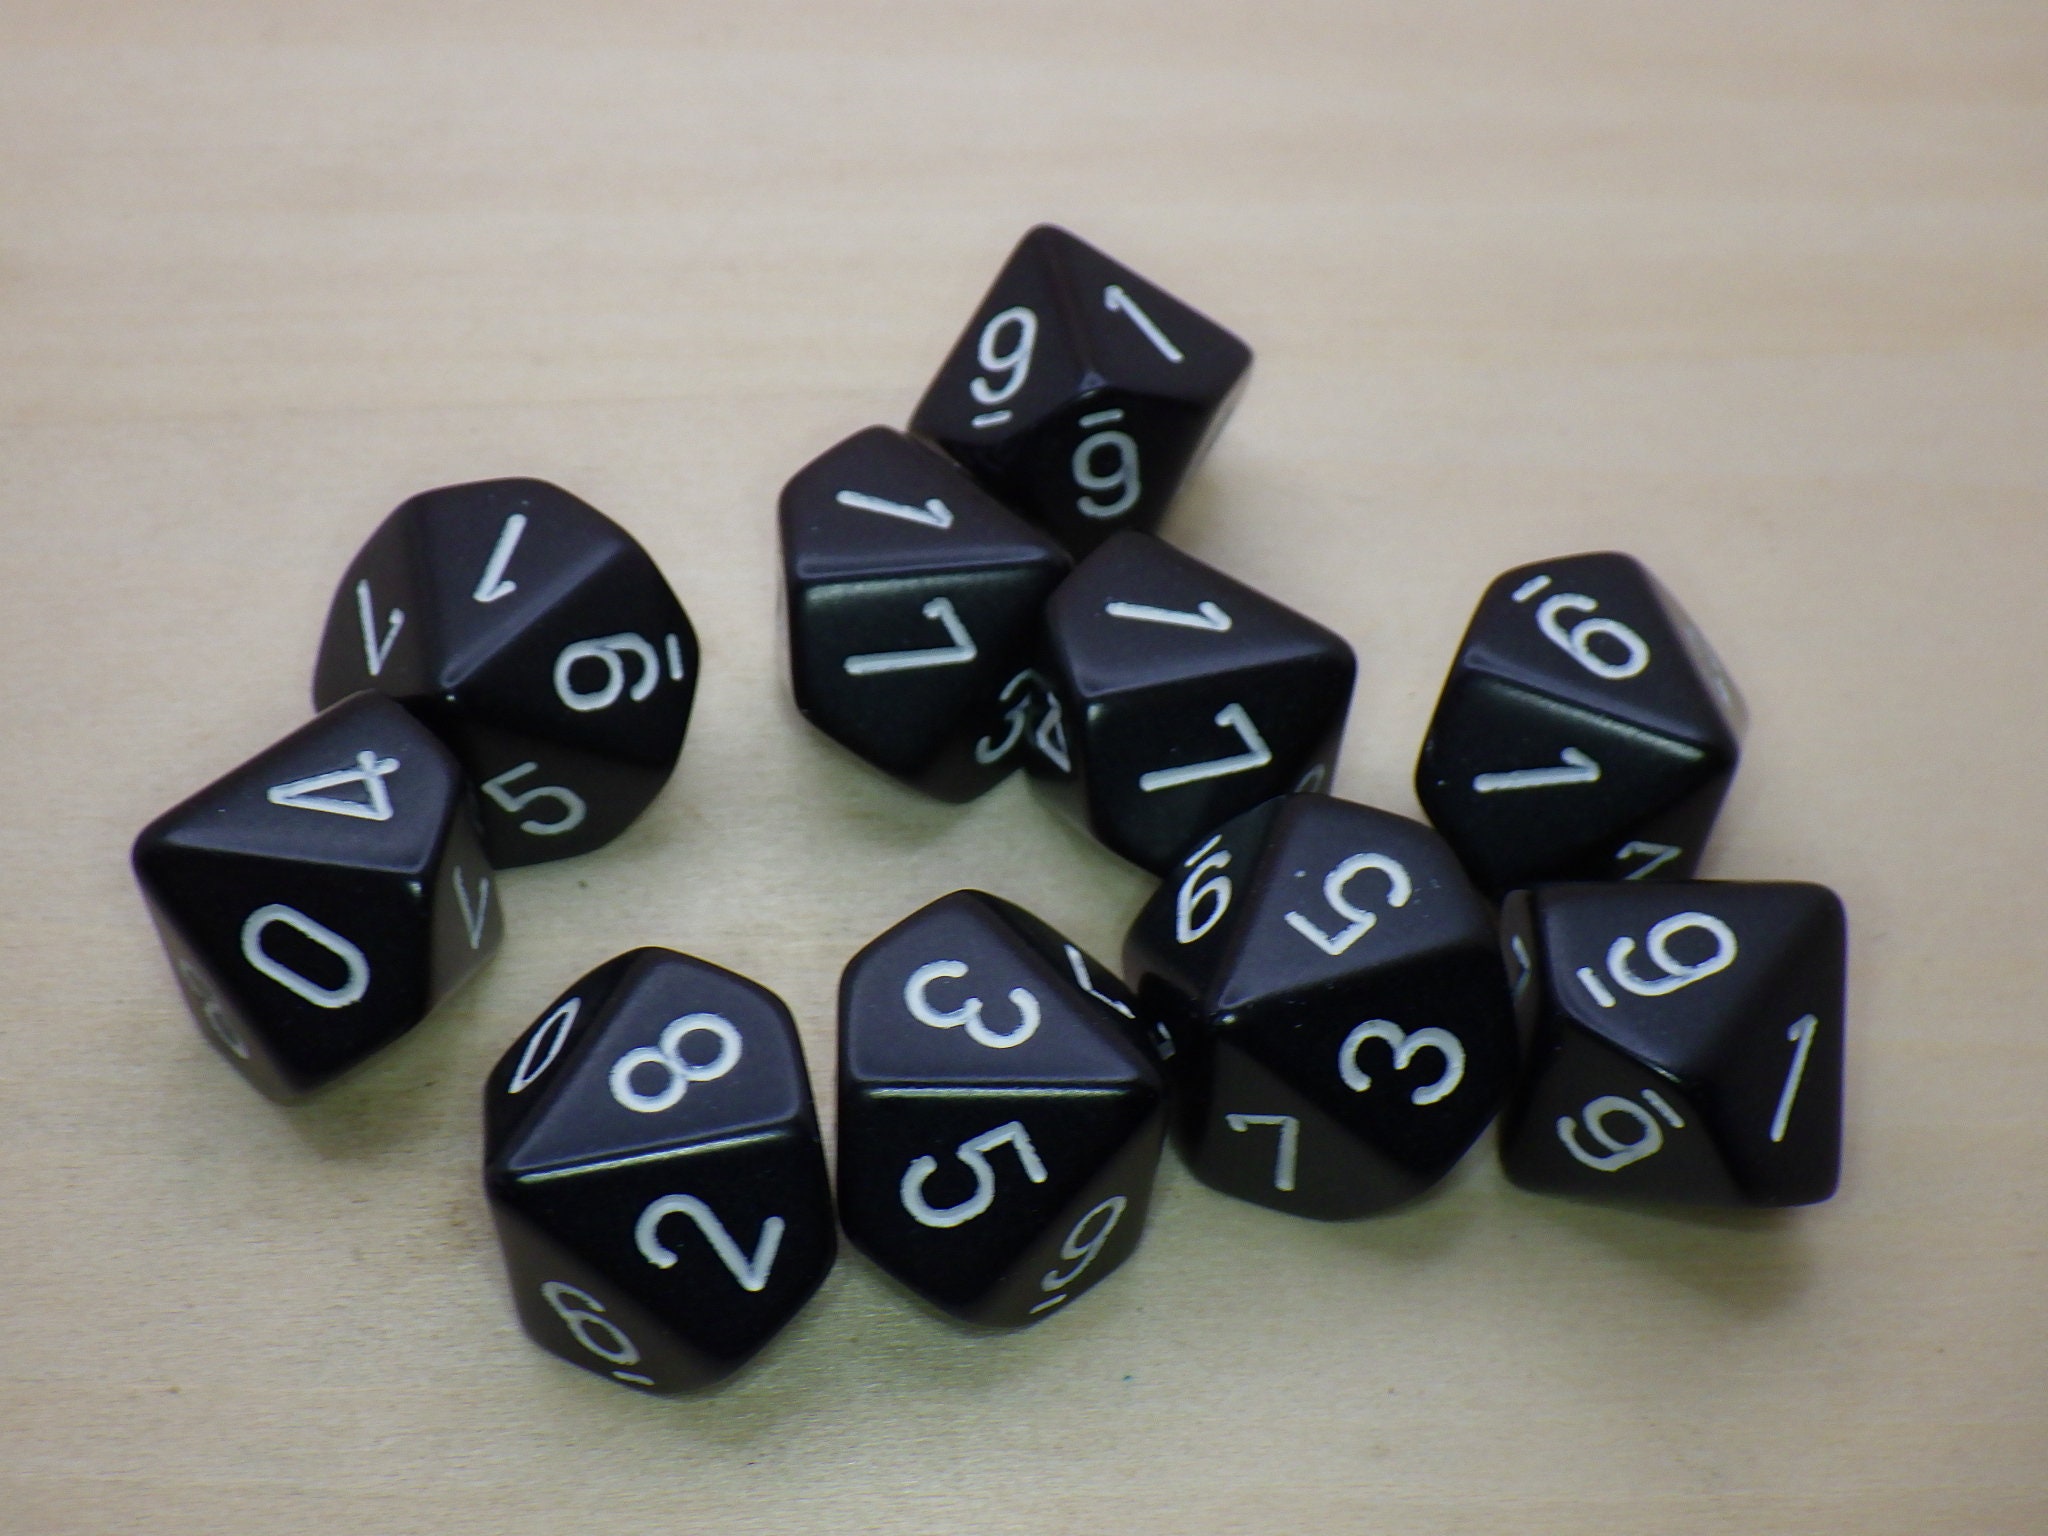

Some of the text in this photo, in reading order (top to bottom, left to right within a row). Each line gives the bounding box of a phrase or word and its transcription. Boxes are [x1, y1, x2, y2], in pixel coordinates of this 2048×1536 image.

[969, 306, 1039, 428] 9
[1104, 285, 1184, 363] 1
[836, 490, 954, 530] 1
[473, 513, 528, 603] 1
[844, 597, 978, 676] 7
[1105, 601, 1233, 632] 1
[267, 751, 401, 821] 4
[1139, 703, 1273, 793] 7
[1473, 748, 1601, 794] 1
[482, 762, 587, 836] 5
[1285, 853, 1413, 955] 5
[241, 903, 370, 1009] 0
[508, 997, 581, 1094] 0
[904, 959, 1041, 1049] 3
[609, 1012, 743, 1114] 8
[1337, 1019, 1467, 1105] 3
[1769, 1014, 1819, 1142] 1
[900, 1120, 1048, 1229] 5
[1226, 1114, 1299, 1191] 7
[635, 1193, 785, 1292] 2
[1029, 1195, 1128, 1314] 9
[541, 1281, 655, 1385] 6
